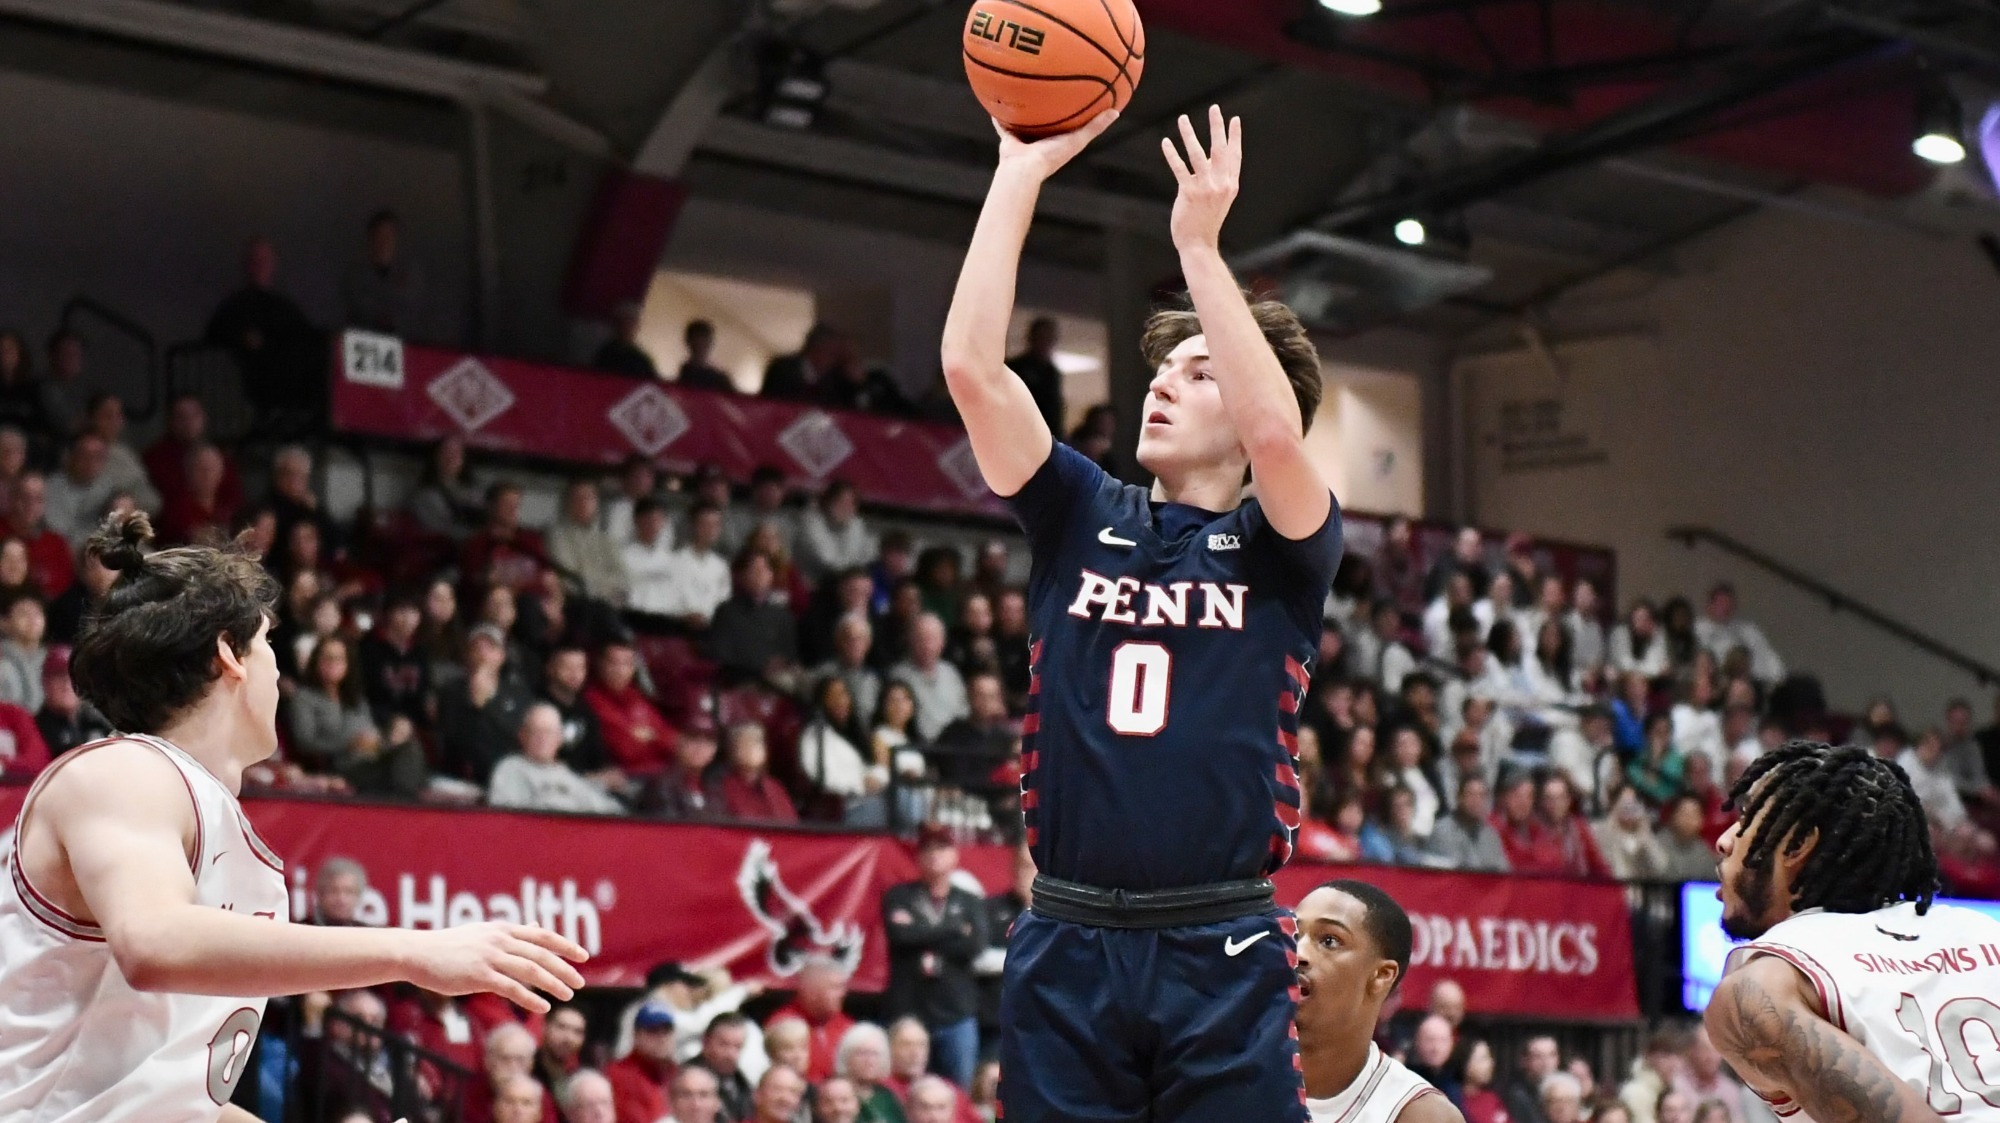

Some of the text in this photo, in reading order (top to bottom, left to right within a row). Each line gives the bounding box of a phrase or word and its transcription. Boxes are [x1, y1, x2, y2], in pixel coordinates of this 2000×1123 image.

[970, 10, 1046, 56] ELITE
[353, 342, 396, 373] 214
[1067, 567, 1249, 631] PENN
[1106, 639, 1174, 737] 0
[1853, 947, 1978, 975] SIMMONS
